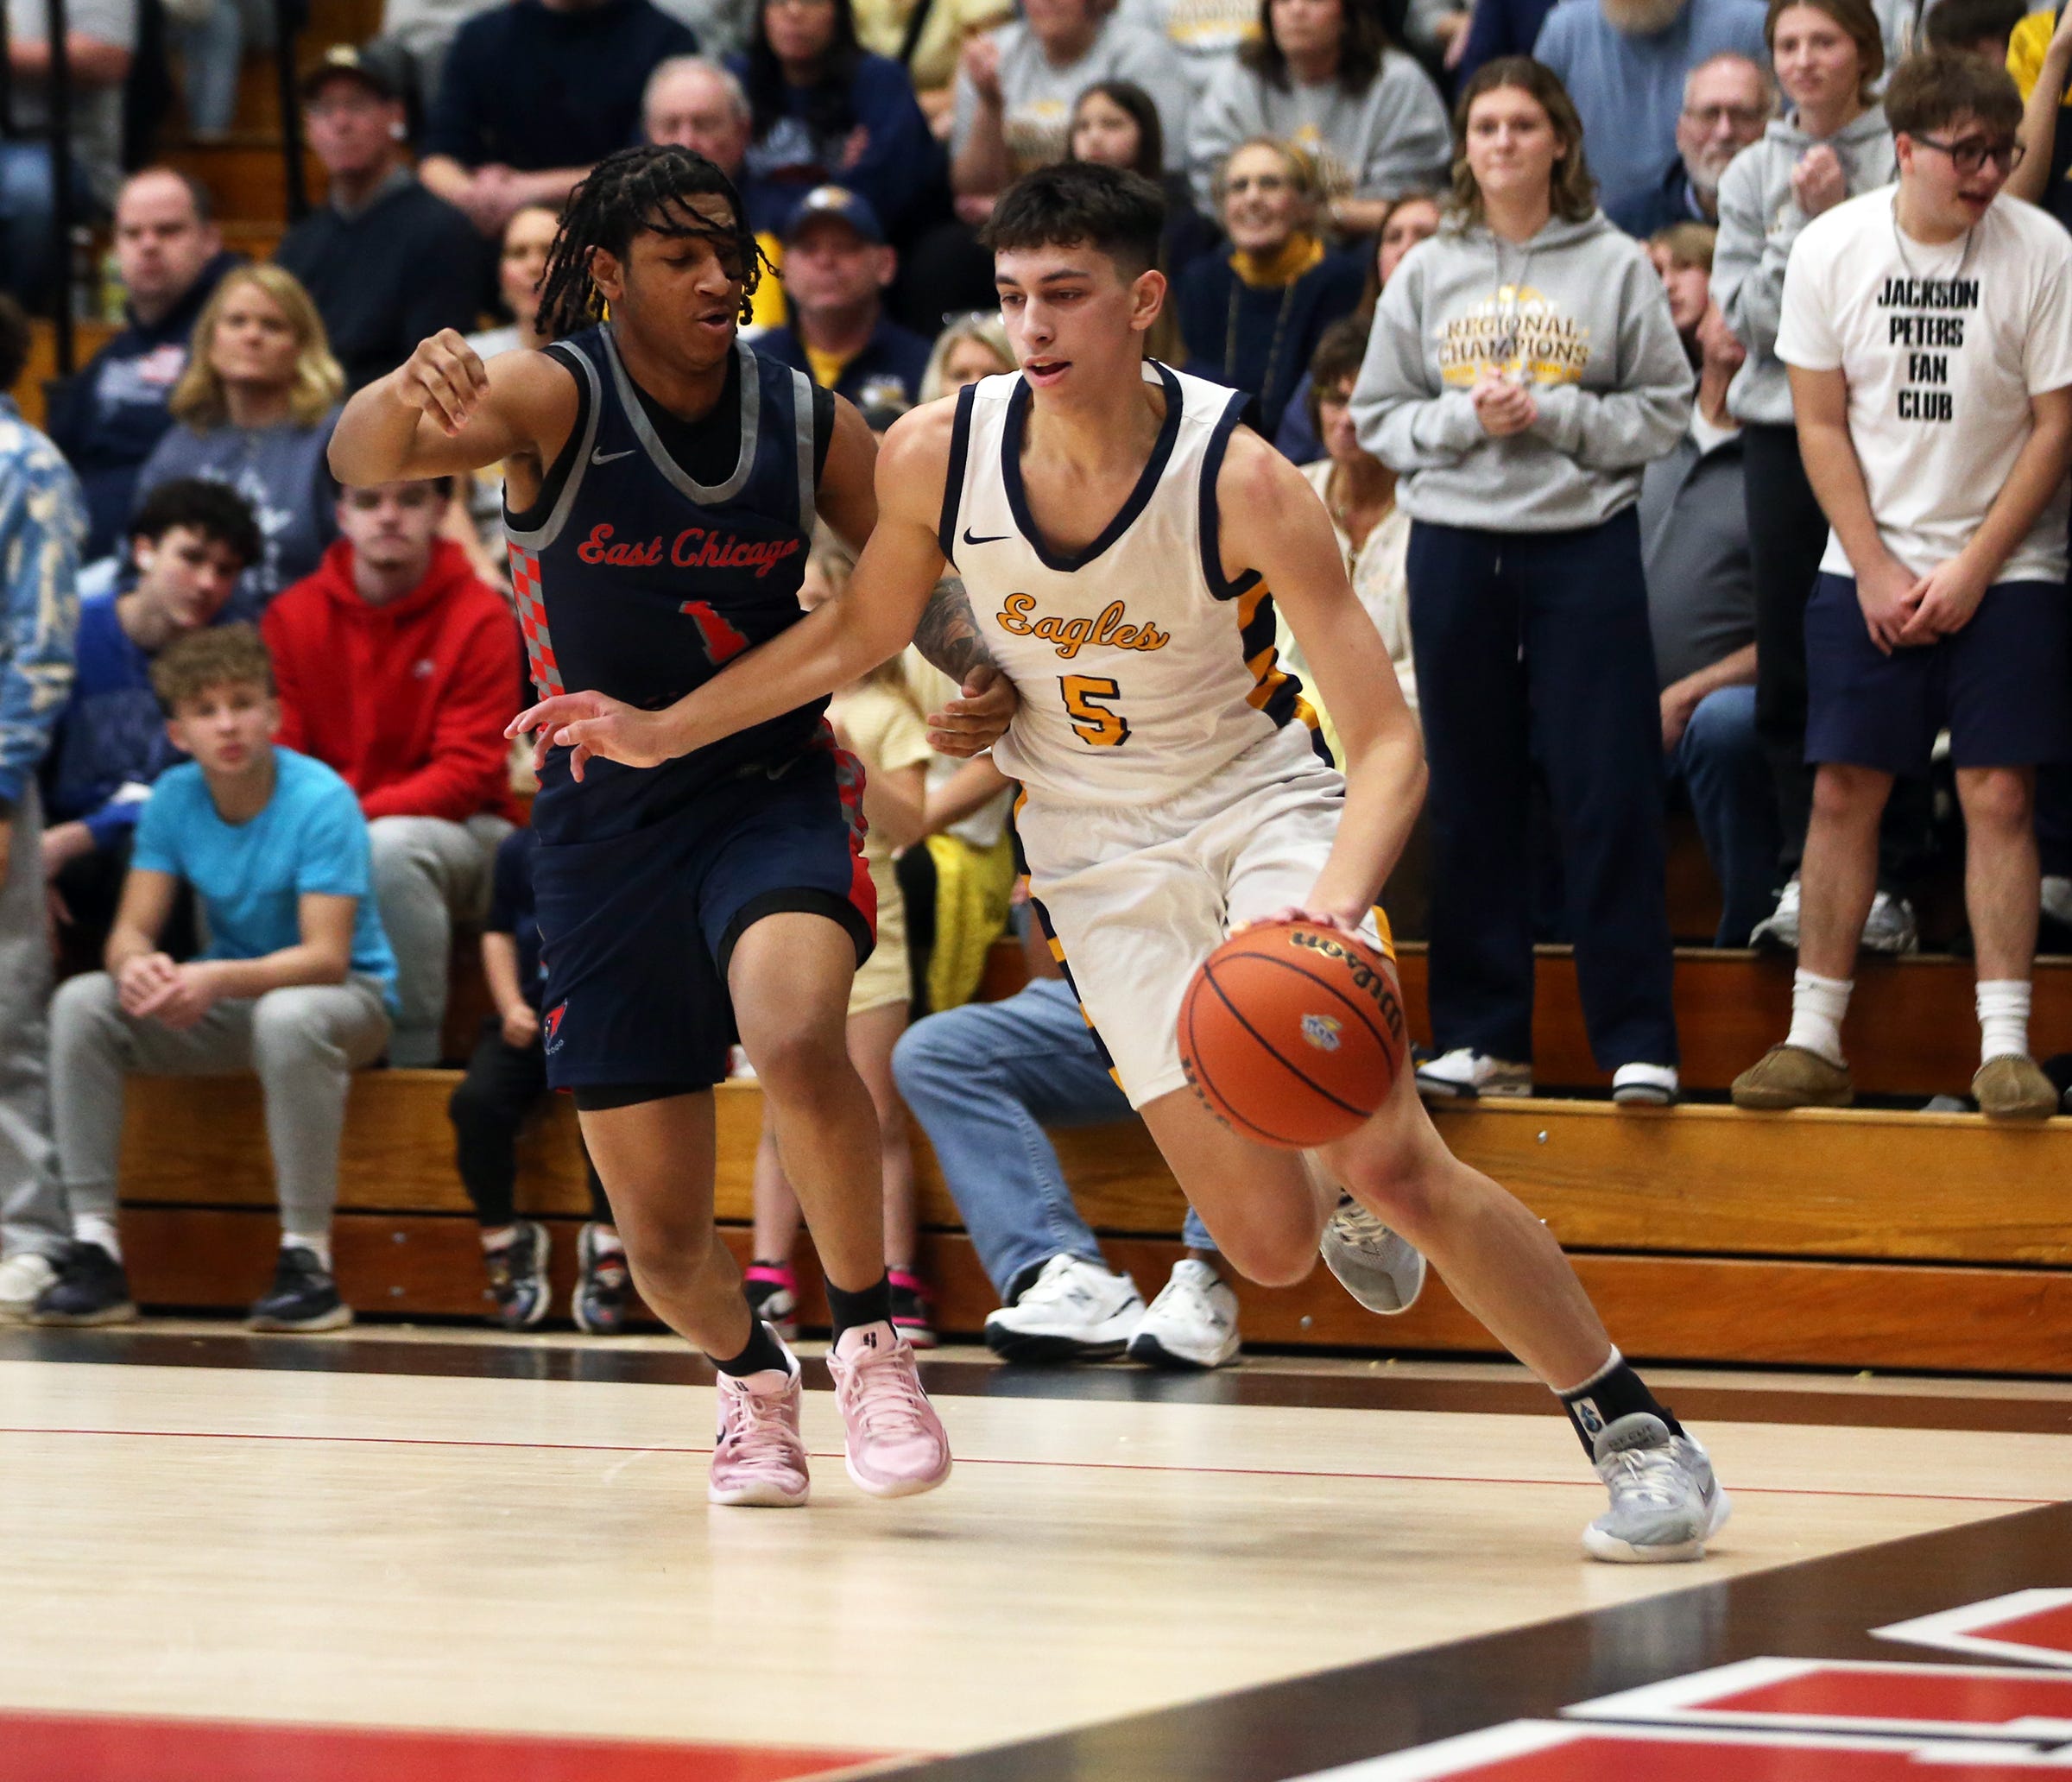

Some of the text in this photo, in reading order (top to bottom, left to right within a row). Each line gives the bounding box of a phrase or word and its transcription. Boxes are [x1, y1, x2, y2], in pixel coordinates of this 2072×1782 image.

[1877, 277, 1980, 309] JACKSON
[1447, 313, 1577, 340] REGIONAL
[1889, 316, 1964, 347] PETERS
[1437, 332, 1590, 367] CHAMPIONS
[1909, 353, 1948, 382] FAN
[1898, 389, 1953, 421] CLUB
[577, 523, 800, 578] East Chicago
[679, 600, 751, 666] 1
[996, 592, 1170, 659] Eagles
[1056, 674, 1132, 746] 5
[1289, 932, 1403, 1043] Wilson
